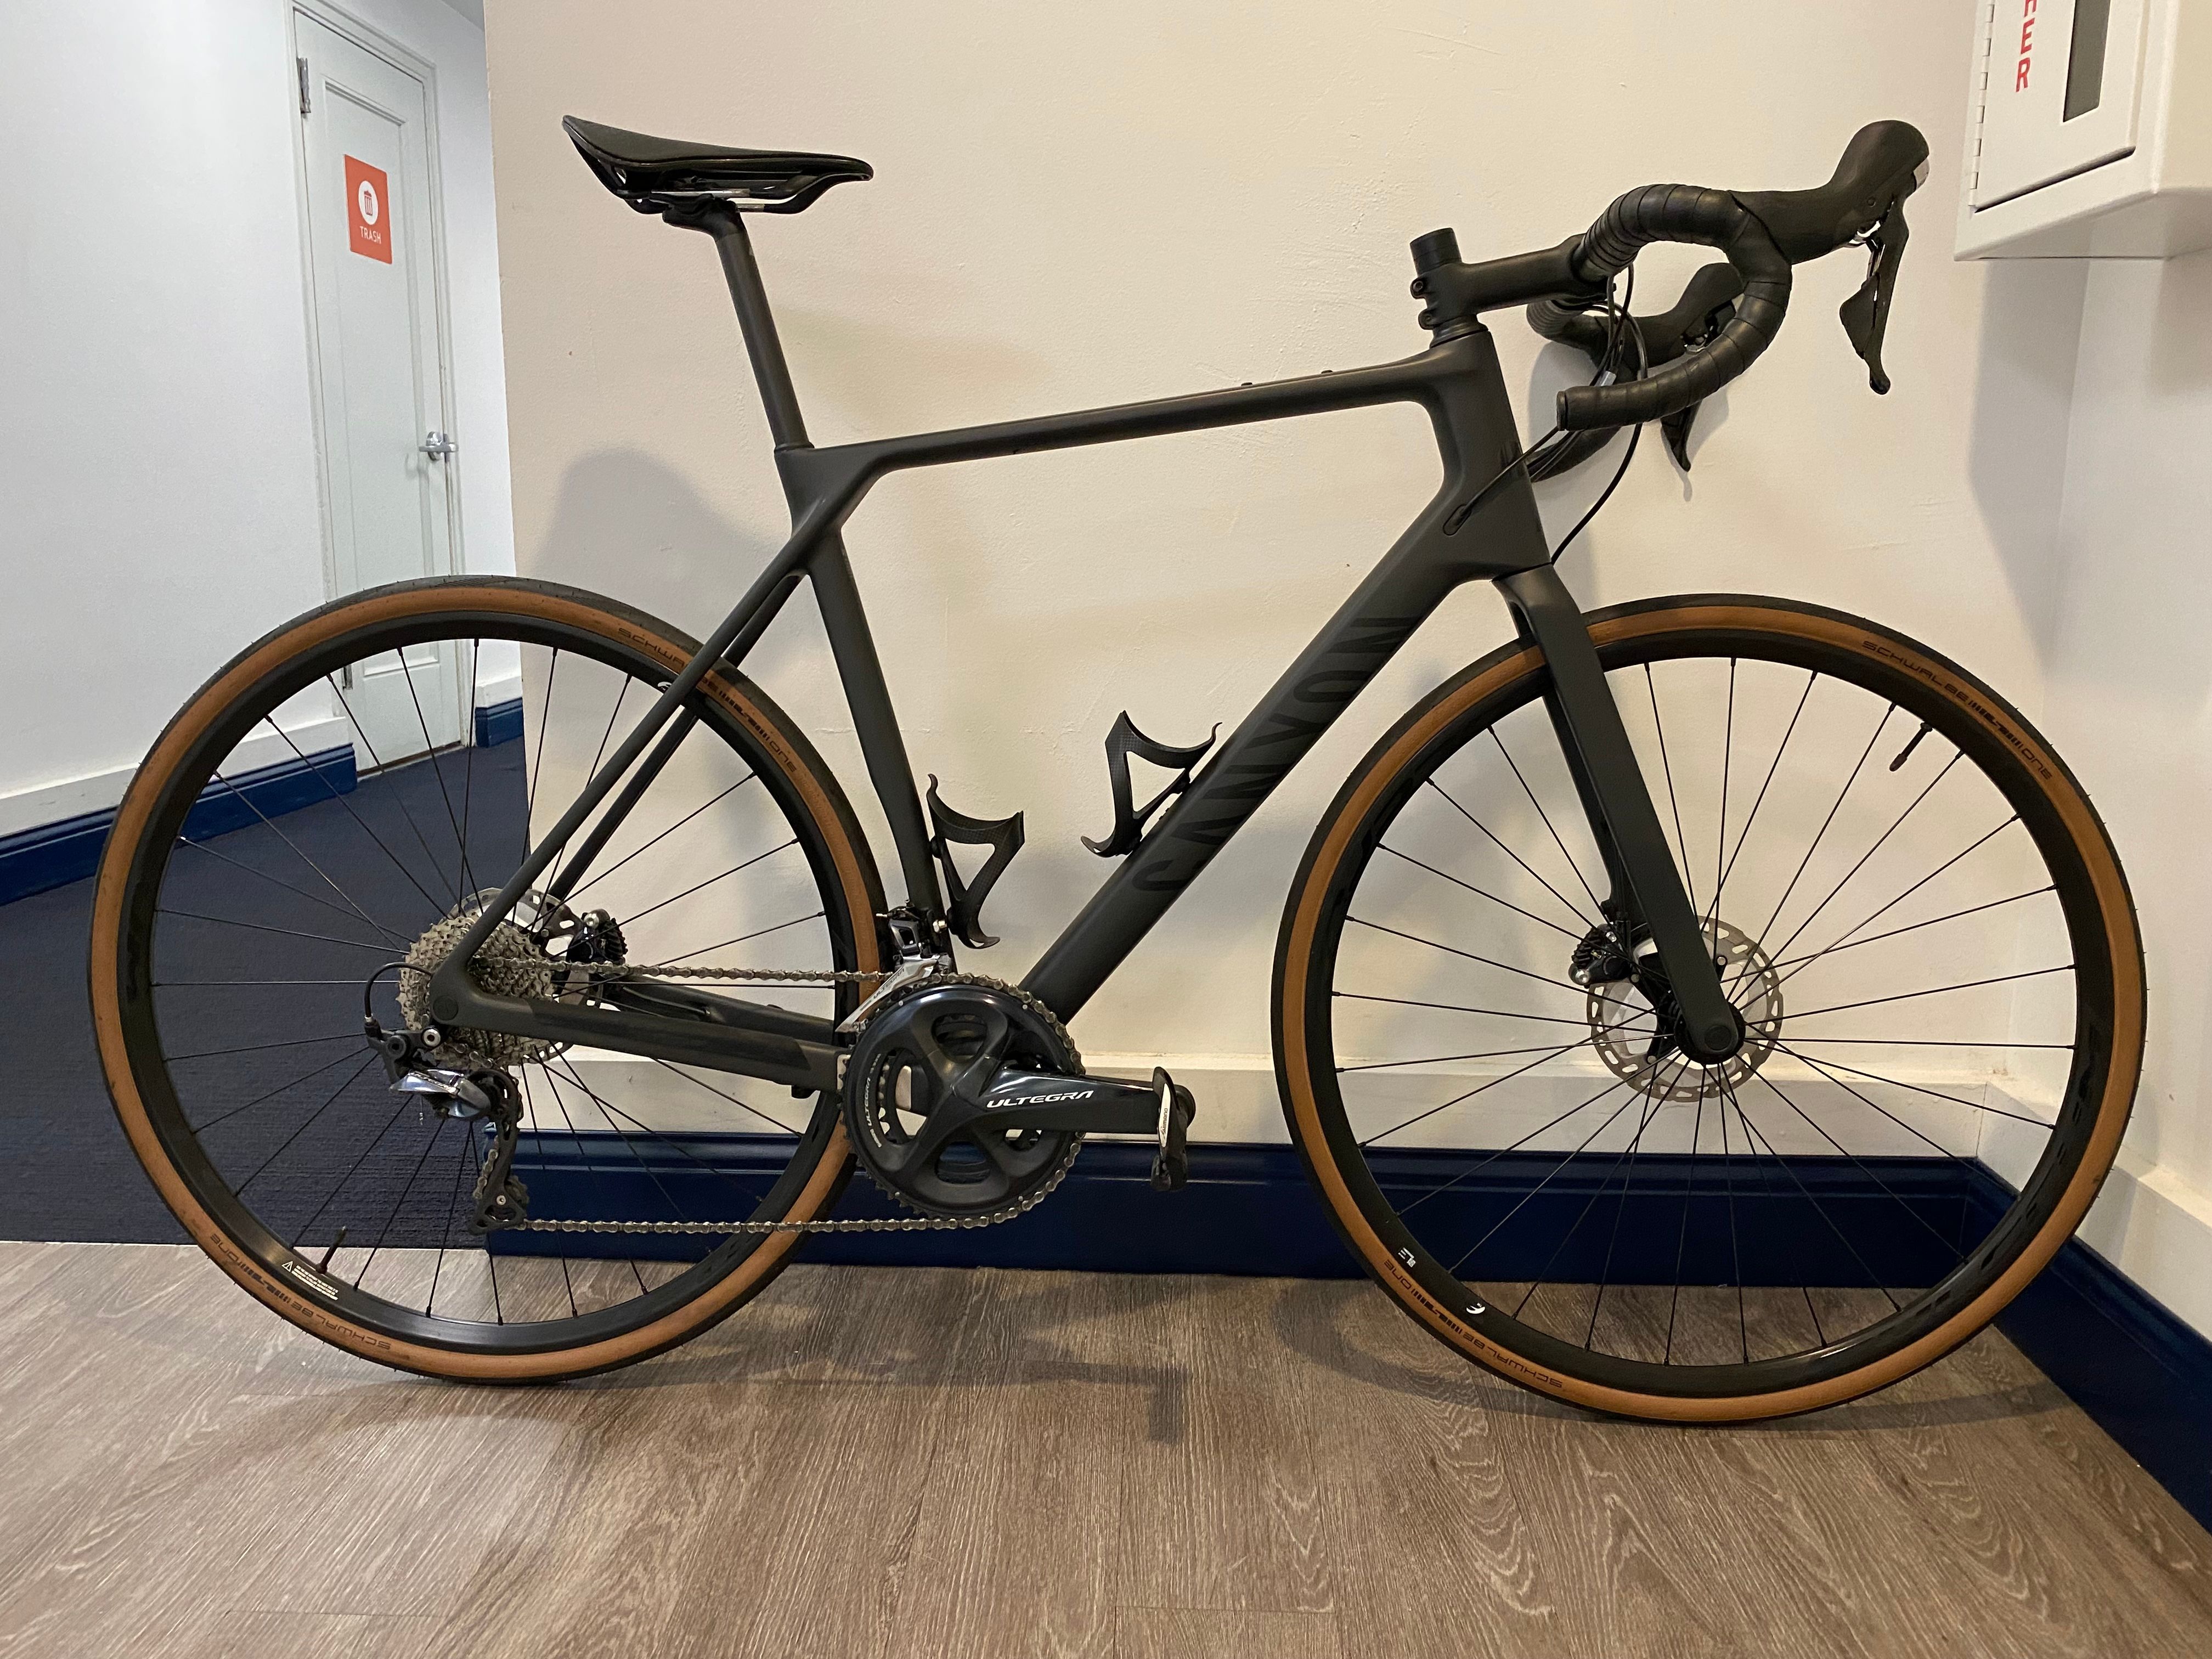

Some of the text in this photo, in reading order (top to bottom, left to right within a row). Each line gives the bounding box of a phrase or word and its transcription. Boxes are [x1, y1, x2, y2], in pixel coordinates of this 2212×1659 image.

[359, 225, 381, 244] TRASH
[1861, 640, 2053, 780] SCHWALBE ONE
[769, 741, 797, 773] ONE
[1131, 617, 1425, 891] CANYON
[864, 1077, 872, 1126] ULTEGRA
[986, 1090, 1094, 1108] ULTEGRA
[1160, 1108, 1169, 1137] SHIMANO
[210, 1233, 391, 1350] SCHWALBE ONE
[1384, 1259, 1563, 1388] SCHWALBE ONE
